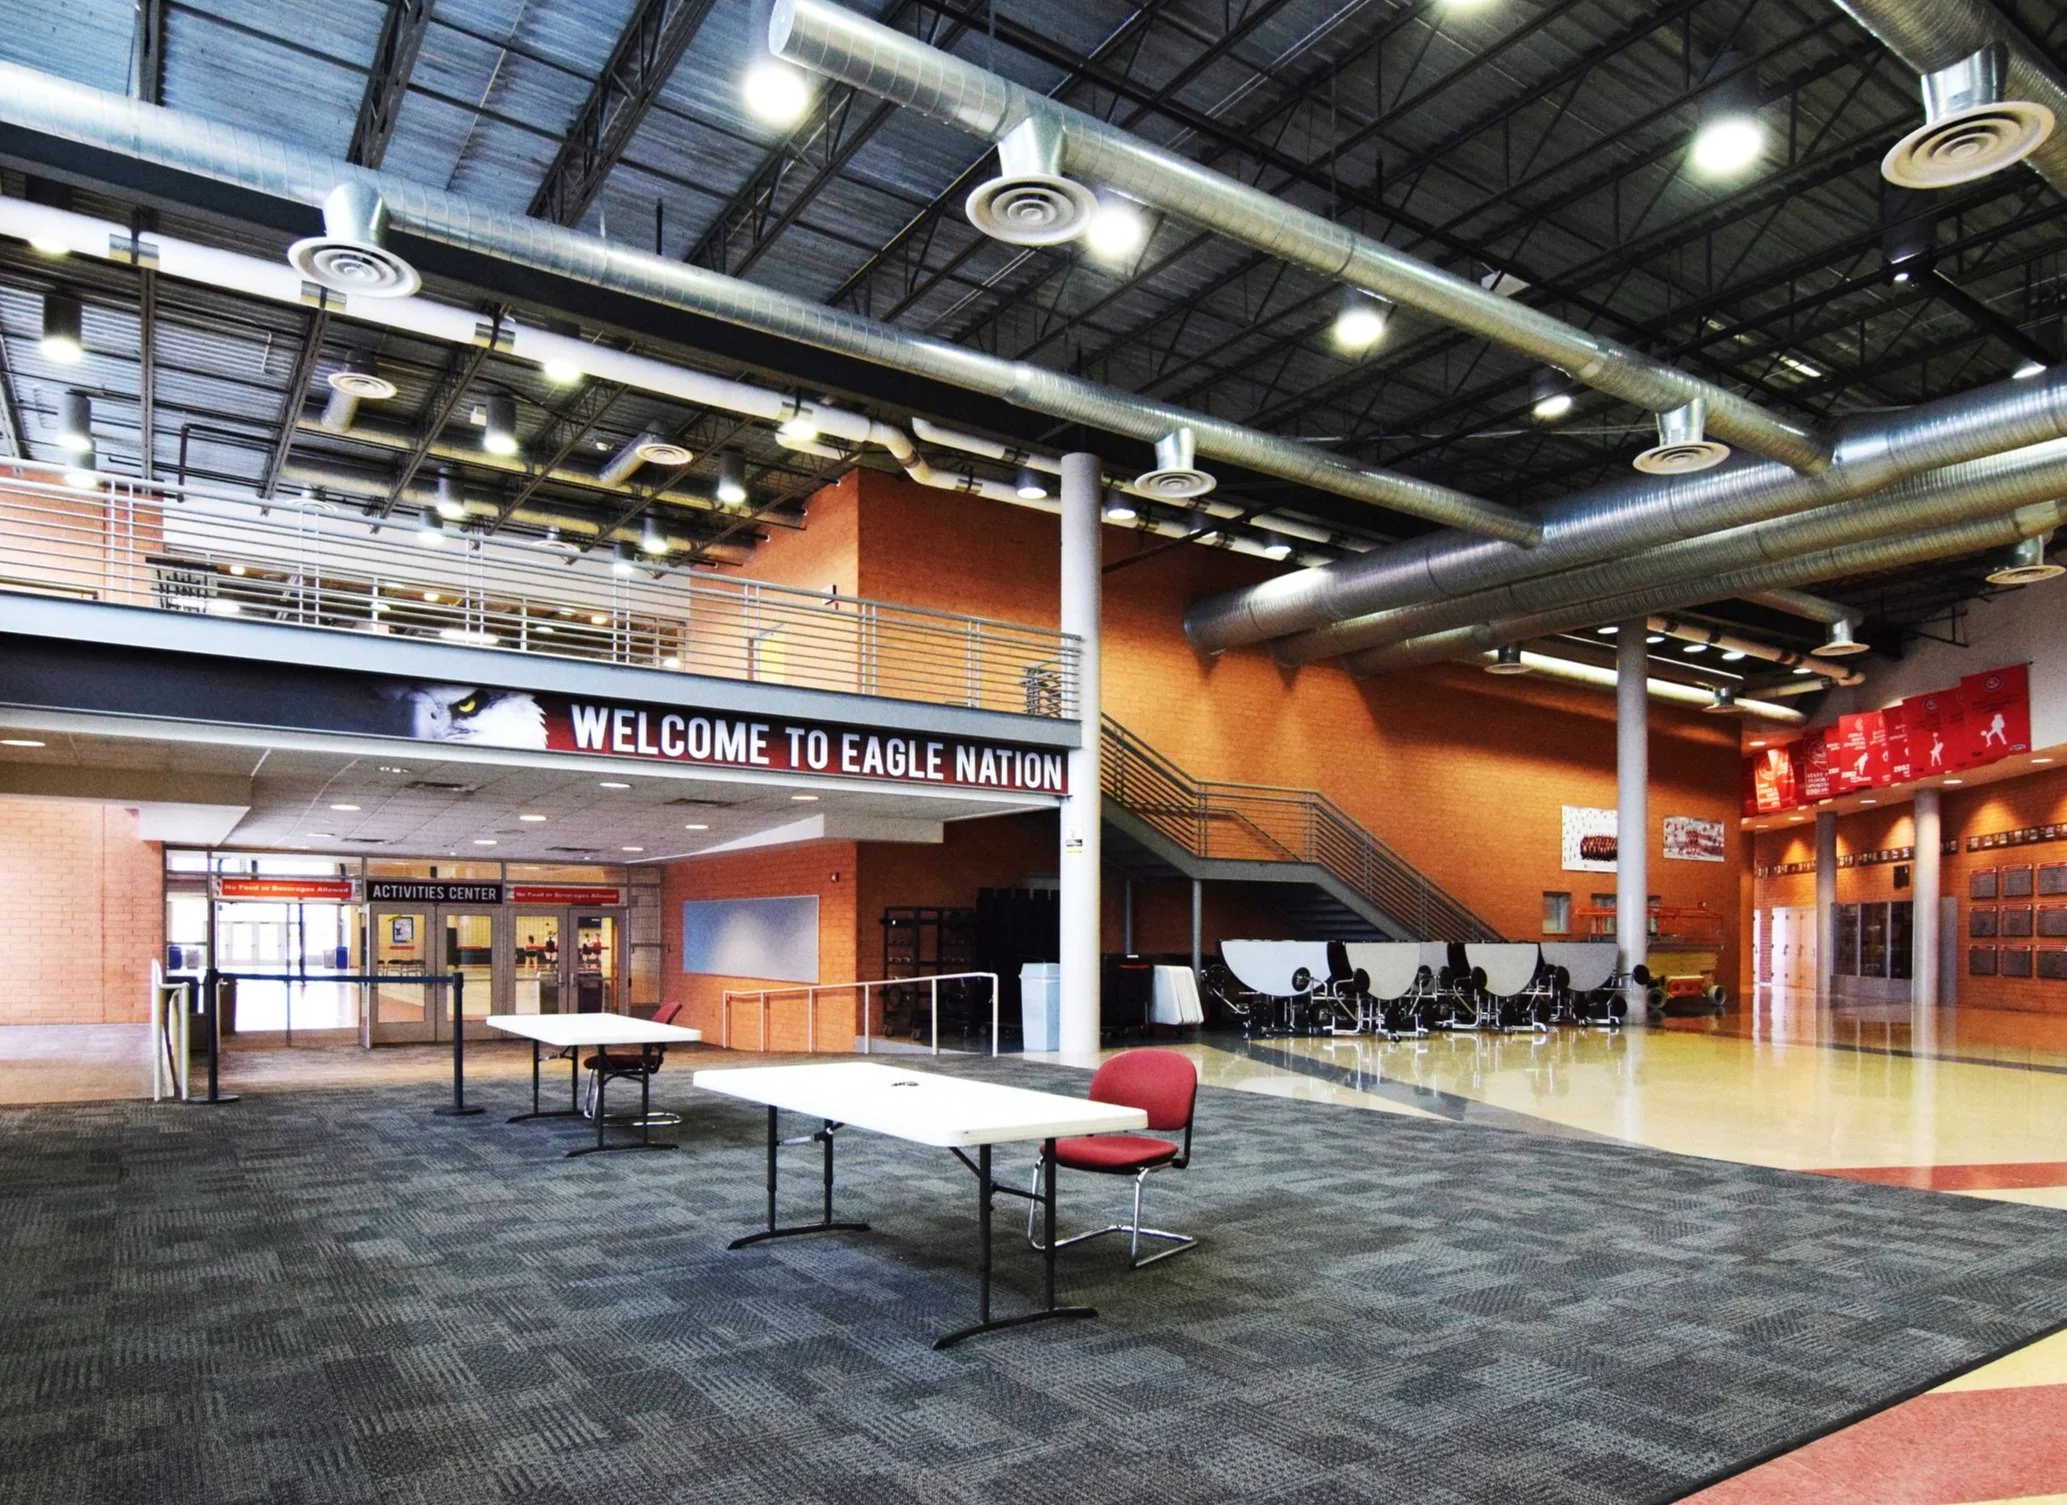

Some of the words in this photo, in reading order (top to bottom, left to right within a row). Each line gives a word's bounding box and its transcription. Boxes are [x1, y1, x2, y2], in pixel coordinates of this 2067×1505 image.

[570, 704, 770, 765] WELCOME
[785, 727, 829, 770] TO
[842, 733, 944, 780] EAGLE
[956, 744, 1062, 791] NATION
[271, 885, 315, 893] Beverages
[372, 885, 445, 899] ACTIVITIES
[449, 886, 497, 900] CENTER
